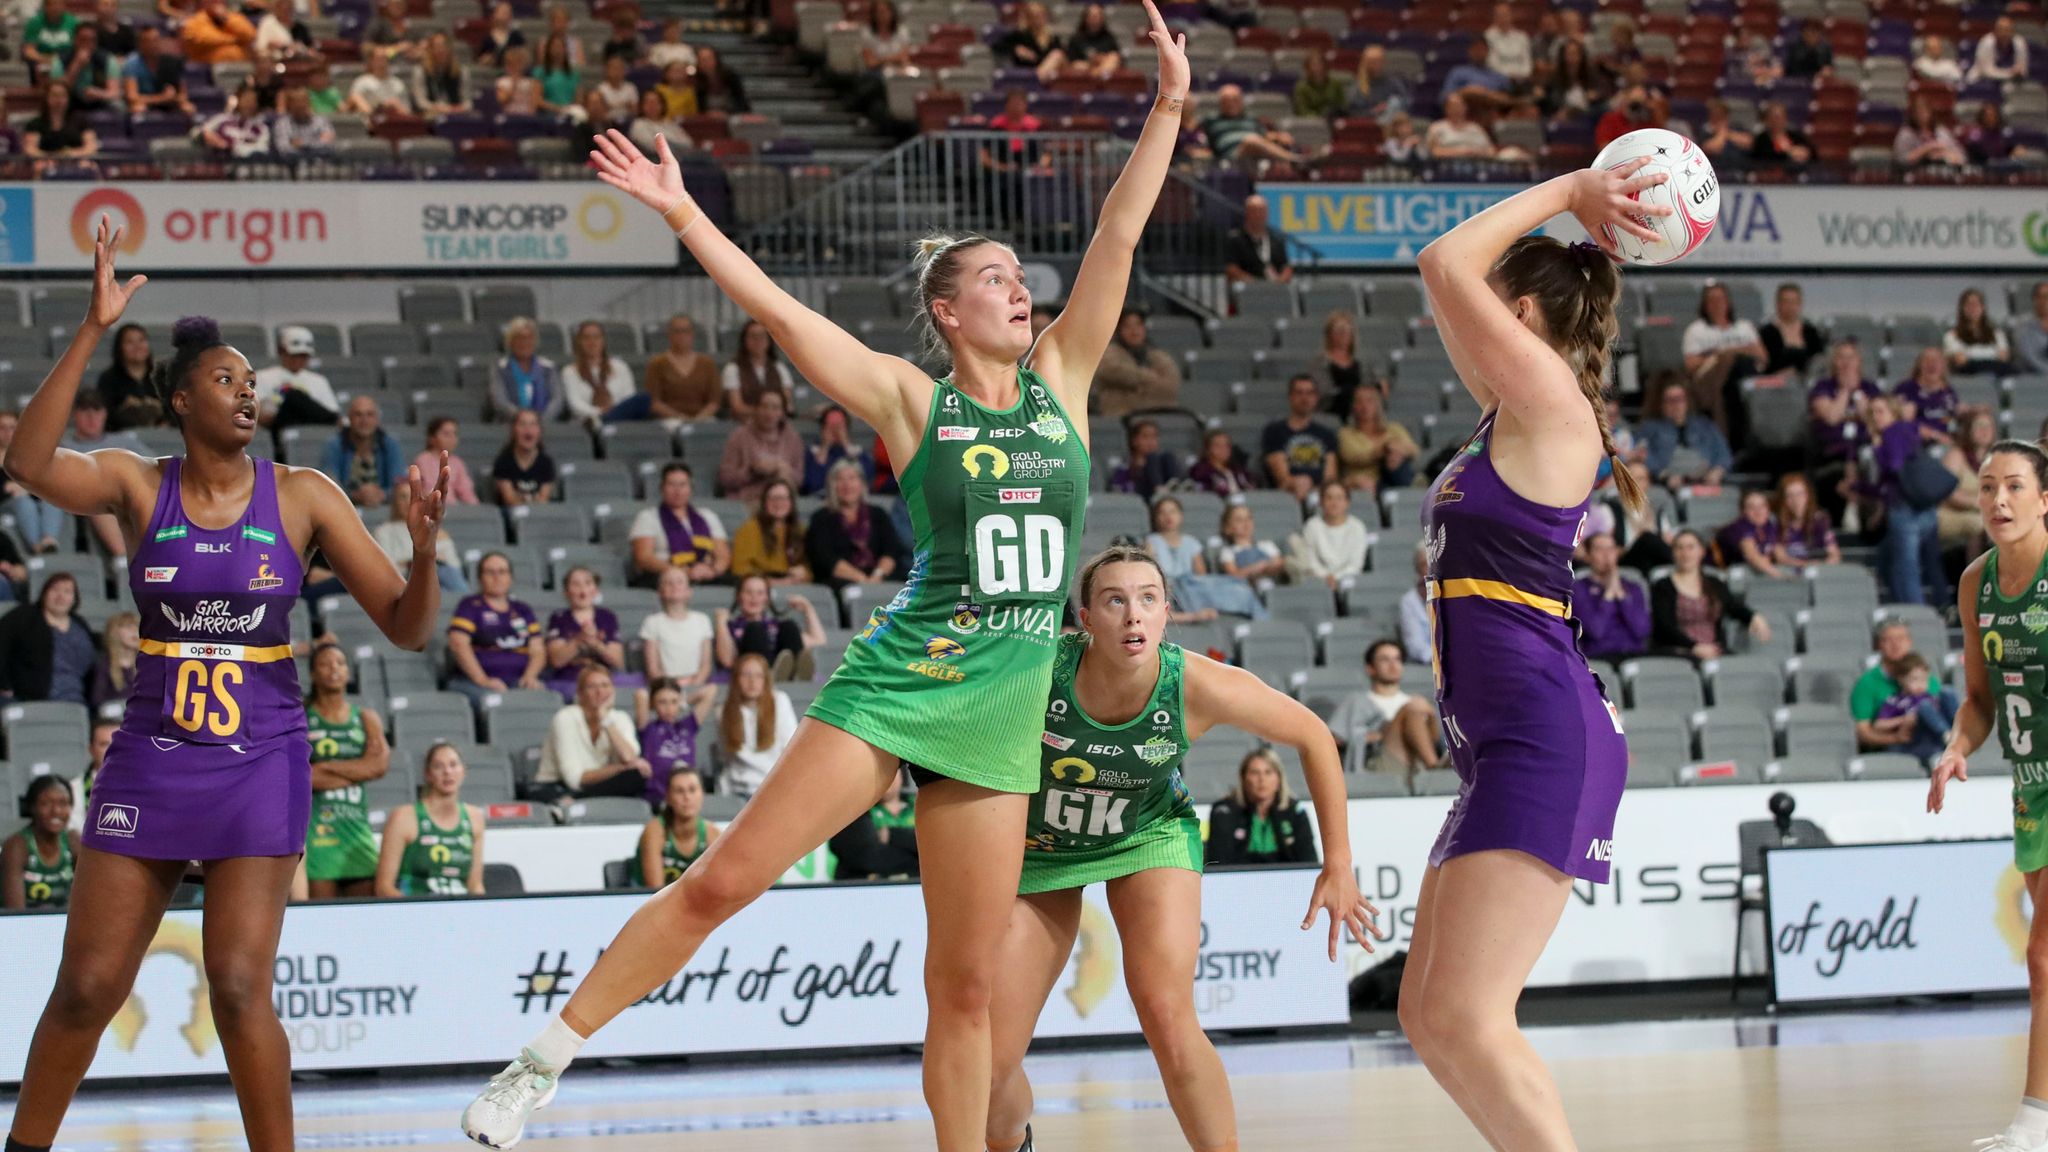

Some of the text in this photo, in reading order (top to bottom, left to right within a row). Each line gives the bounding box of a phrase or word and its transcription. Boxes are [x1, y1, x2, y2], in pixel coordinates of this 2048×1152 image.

[422, 204, 568, 231] SUNCORP
[1280, 194, 1502, 233] LIVELIGHT
[164, 208, 328, 265] origin
[1817, 206, 2017, 249] Woolworths
[424, 234, 569, 259] TEAM GIRLS
[989, 429, 1014, 438] ISC
[1011, 451, 1041, 461] GOLD
[1012, 459, 1066, 470] INDUSTRY
[1013, 469, 1052, 479] GROUP
[1014, 491, 1039, 500] HCF
[194, 542, 233, 553] BLK
[975, 514, 1064, 595] GD
[249, 578, 283, 591] FIREBIRDS
[180, 612, 251, 634] WARRIOR
[987, 605, 1057, 640] UWA
[190, 646, 232, 657] oporto
[906, 662, 966, 683] EAGLES
[172, 659, 244, 737] GS
[1046, 712, 1066, 722] origin
[2006, 693, 2033, 756] C
[1152, 724, 1173, 733] origin
[1086, 744, 1113, 755] ISC
[1141, 744, 1176, 758] FEVER
[1097, 776, 1153, 785] INDUSTRY
[1099, 769, 1129, 779] GOLD
[1044, 788, 1131, 837] GK
[1778, 896, 1918, 978] of gold
[273, 955, 339, 985] OLD
[737, 945, 790, 1001] of
[779, 939, 901, 1027] gold
[273, 985, 418, 1018] NDUSTRY
